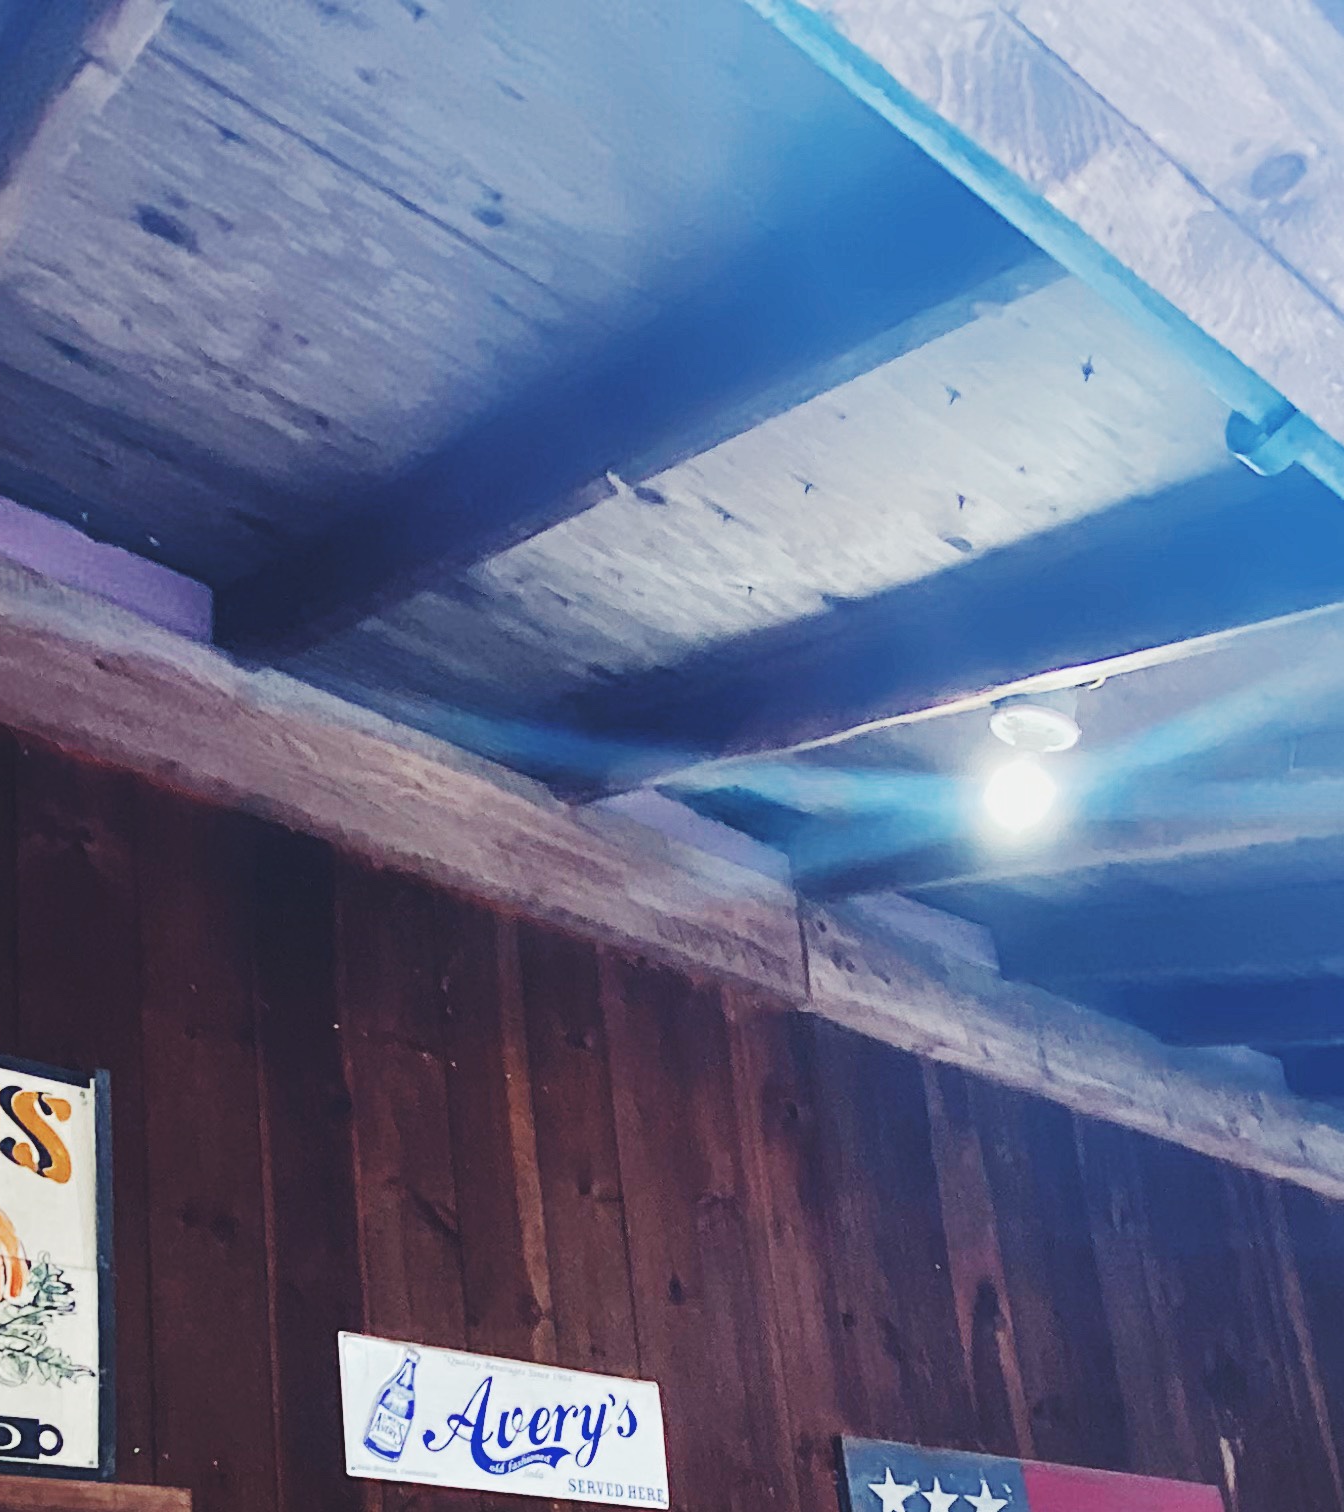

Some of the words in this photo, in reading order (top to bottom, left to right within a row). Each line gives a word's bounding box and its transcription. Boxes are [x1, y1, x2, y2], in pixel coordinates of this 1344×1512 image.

[422, 1376, 638, 1474] Avery's
[568, 1479, 624, 1498] SERVED
[628, 1484, 665, 1502] HERE
